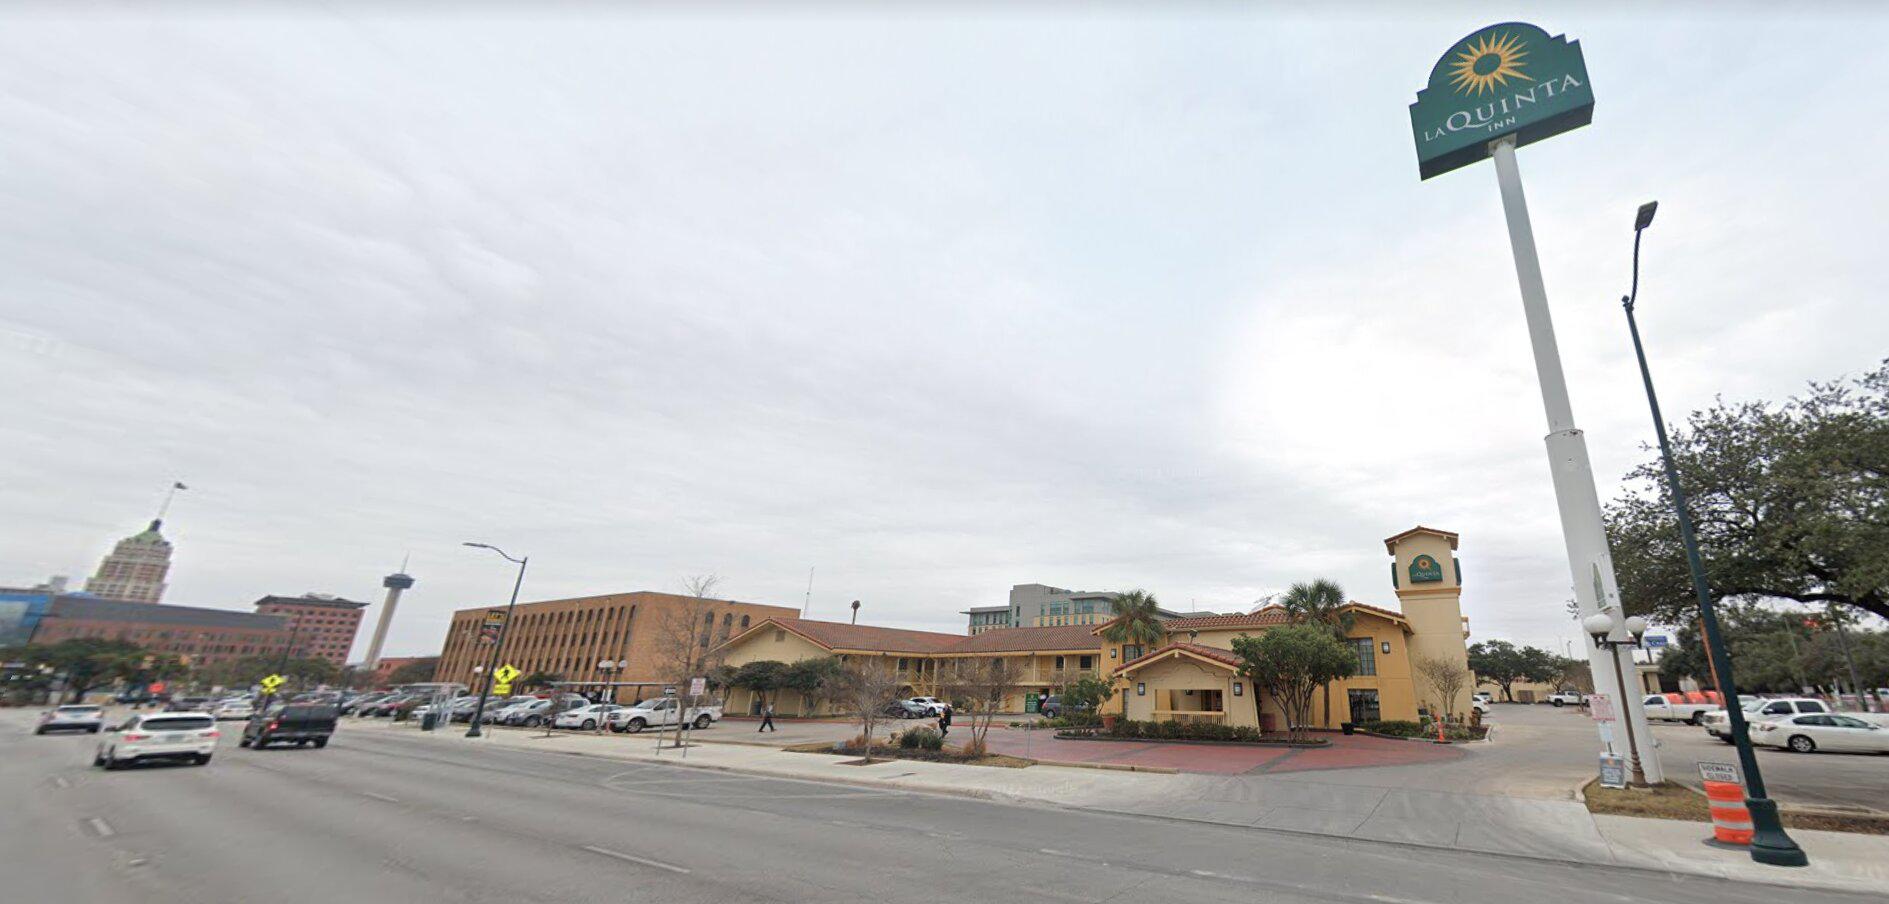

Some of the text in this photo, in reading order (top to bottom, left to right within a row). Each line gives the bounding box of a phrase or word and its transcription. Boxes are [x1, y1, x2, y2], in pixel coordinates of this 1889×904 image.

[1424, 73, 1583, 142] LA QUINTA
[1488, 116, 1516, 132] INN
